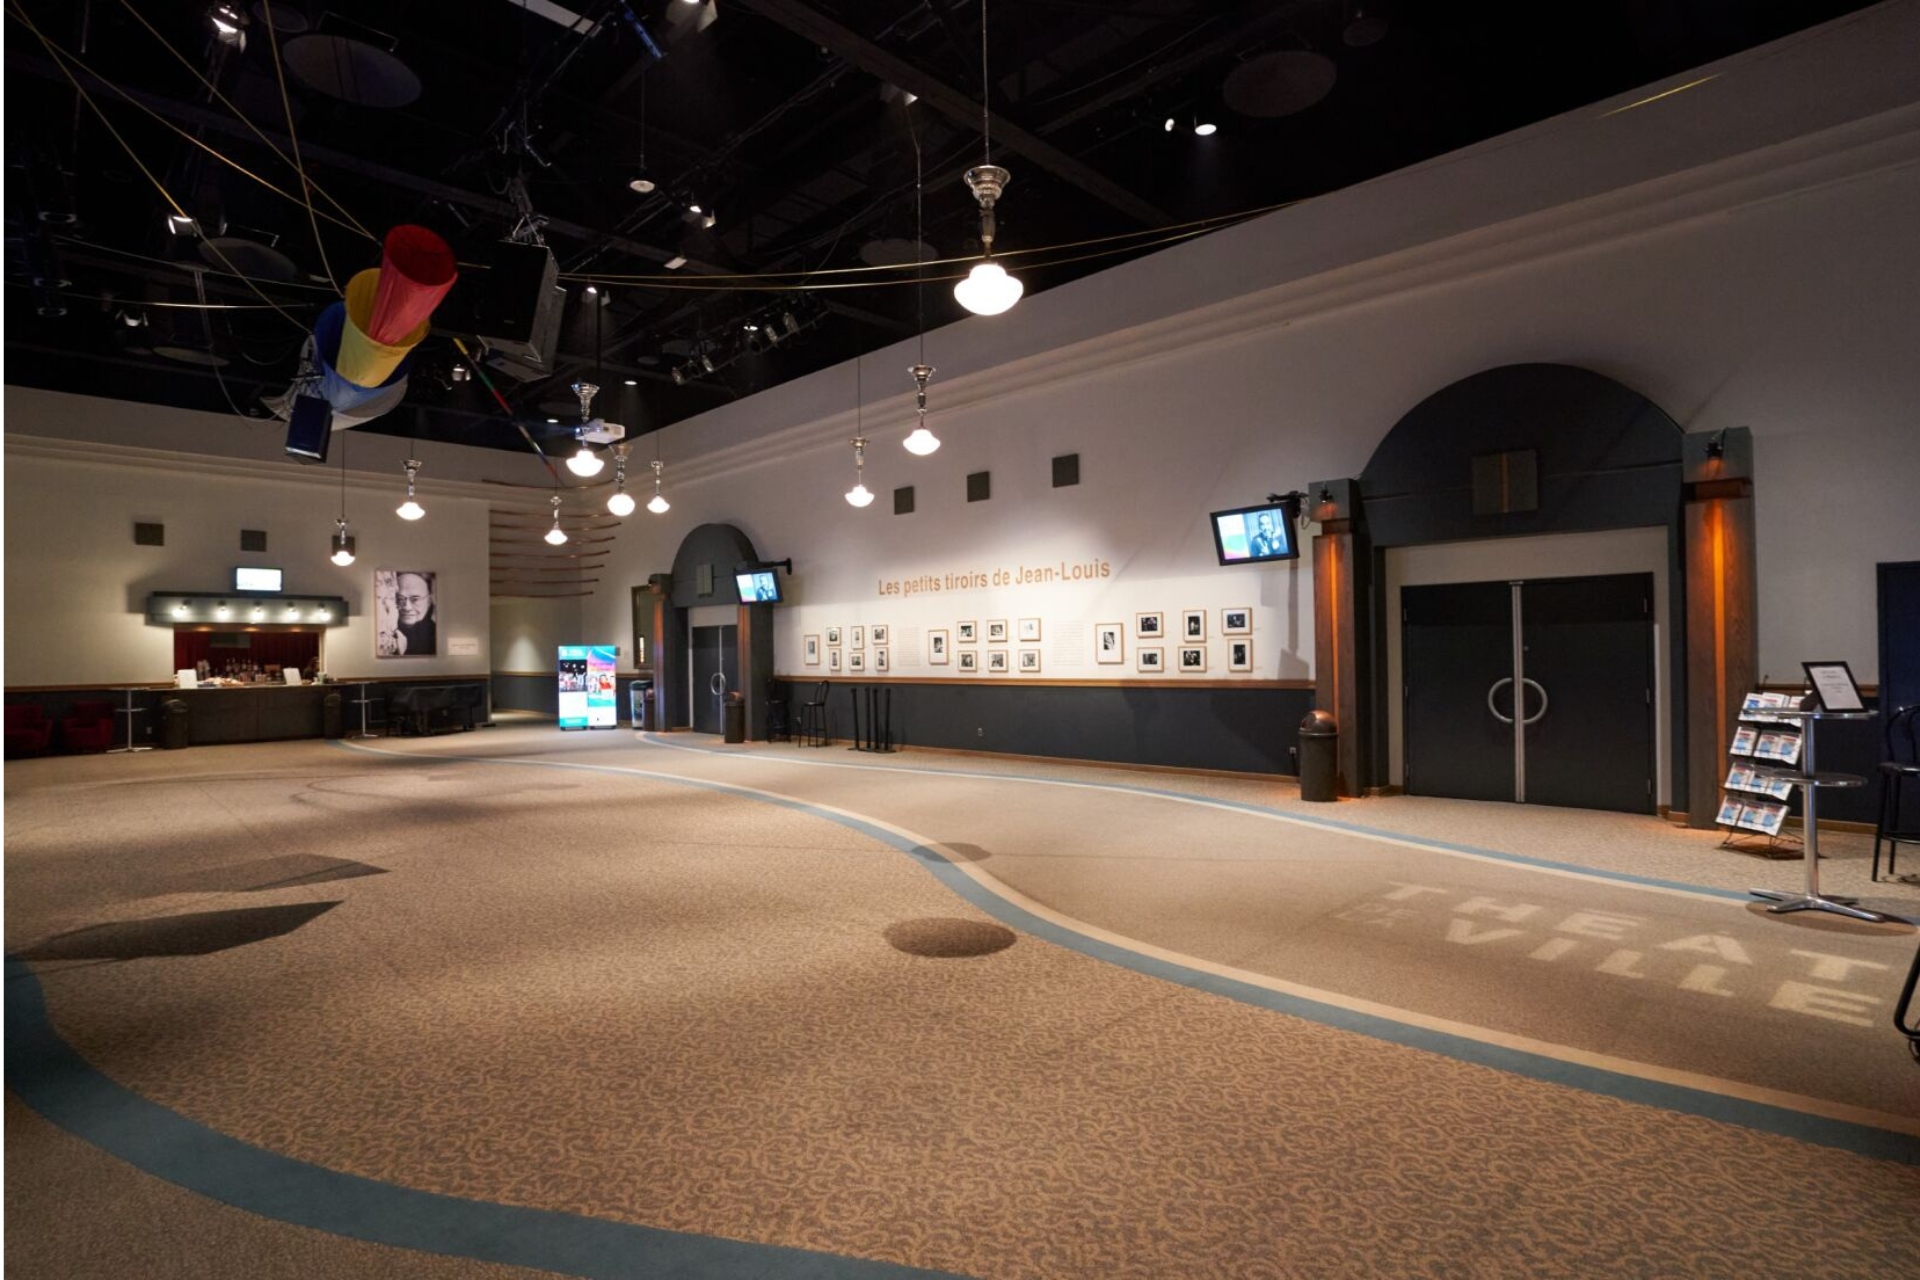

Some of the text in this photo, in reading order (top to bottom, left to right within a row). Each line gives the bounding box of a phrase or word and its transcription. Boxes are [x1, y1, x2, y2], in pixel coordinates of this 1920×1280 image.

[878, 558, 1111, 597] Les petits tiroirs de Jean-Louis
[1445, 918, 1886, 1028] VILLE
